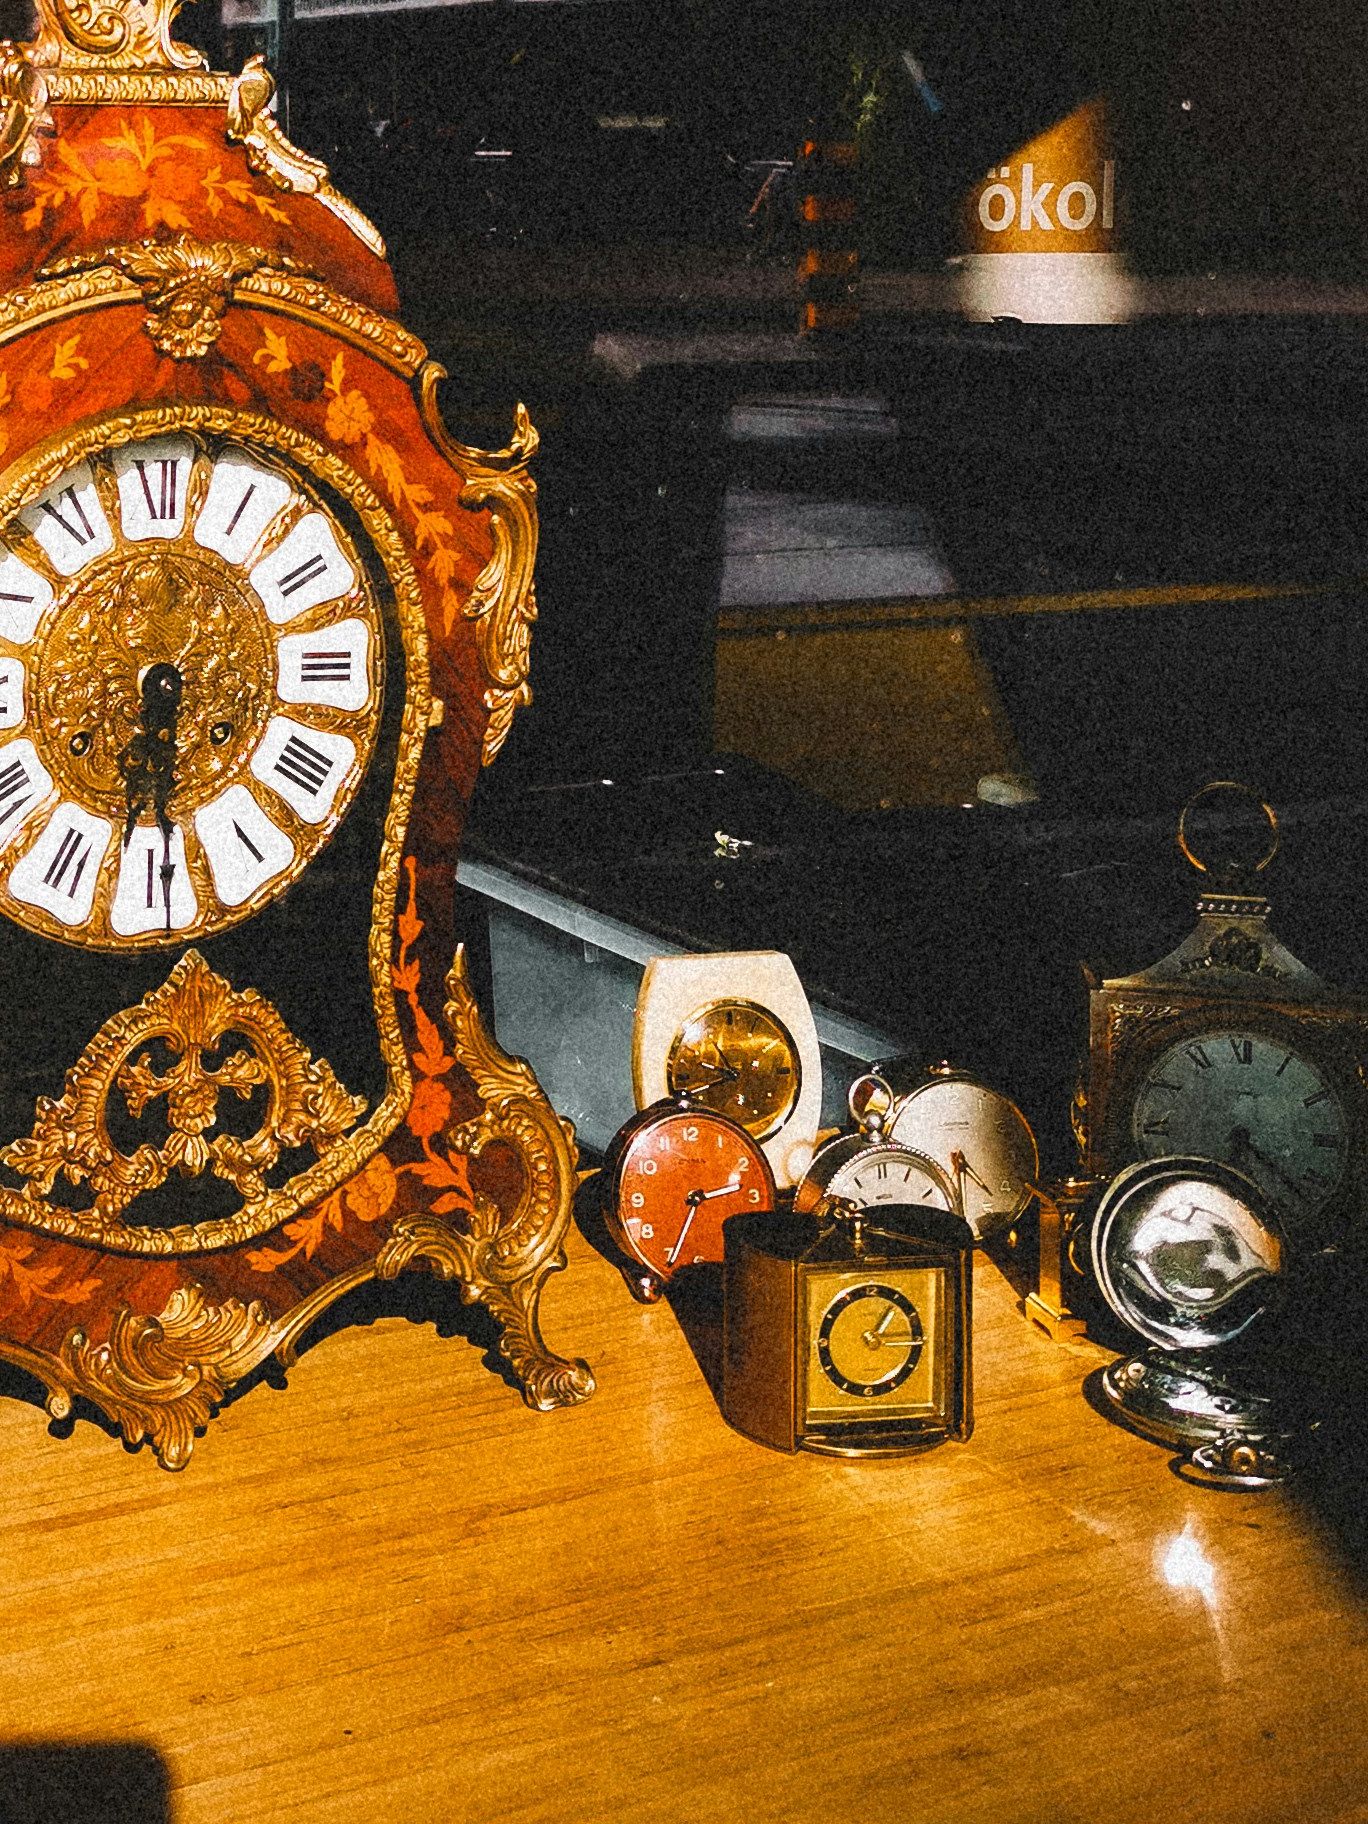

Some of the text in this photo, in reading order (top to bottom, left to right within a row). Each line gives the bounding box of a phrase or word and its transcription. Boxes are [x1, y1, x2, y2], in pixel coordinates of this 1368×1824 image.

[978, 160, 1115, 232] ökol
[130, 459, 181, 520] XII
[276, 553, 329, 599] II
[301, 651, 351, 682] III
[682, 1126, 699, 1142] 12
[717, 1135, 724, 1149] 1
[659, 1137, 670, 1152] 11
[638, 1160, 658, 1175] 10
[738, 1157, 750, 1173] 2
[631, 1192, 645, 1208] 9
[748, 1188, 761, 1204] 3
[641, 1224, 655, 1239] 8
